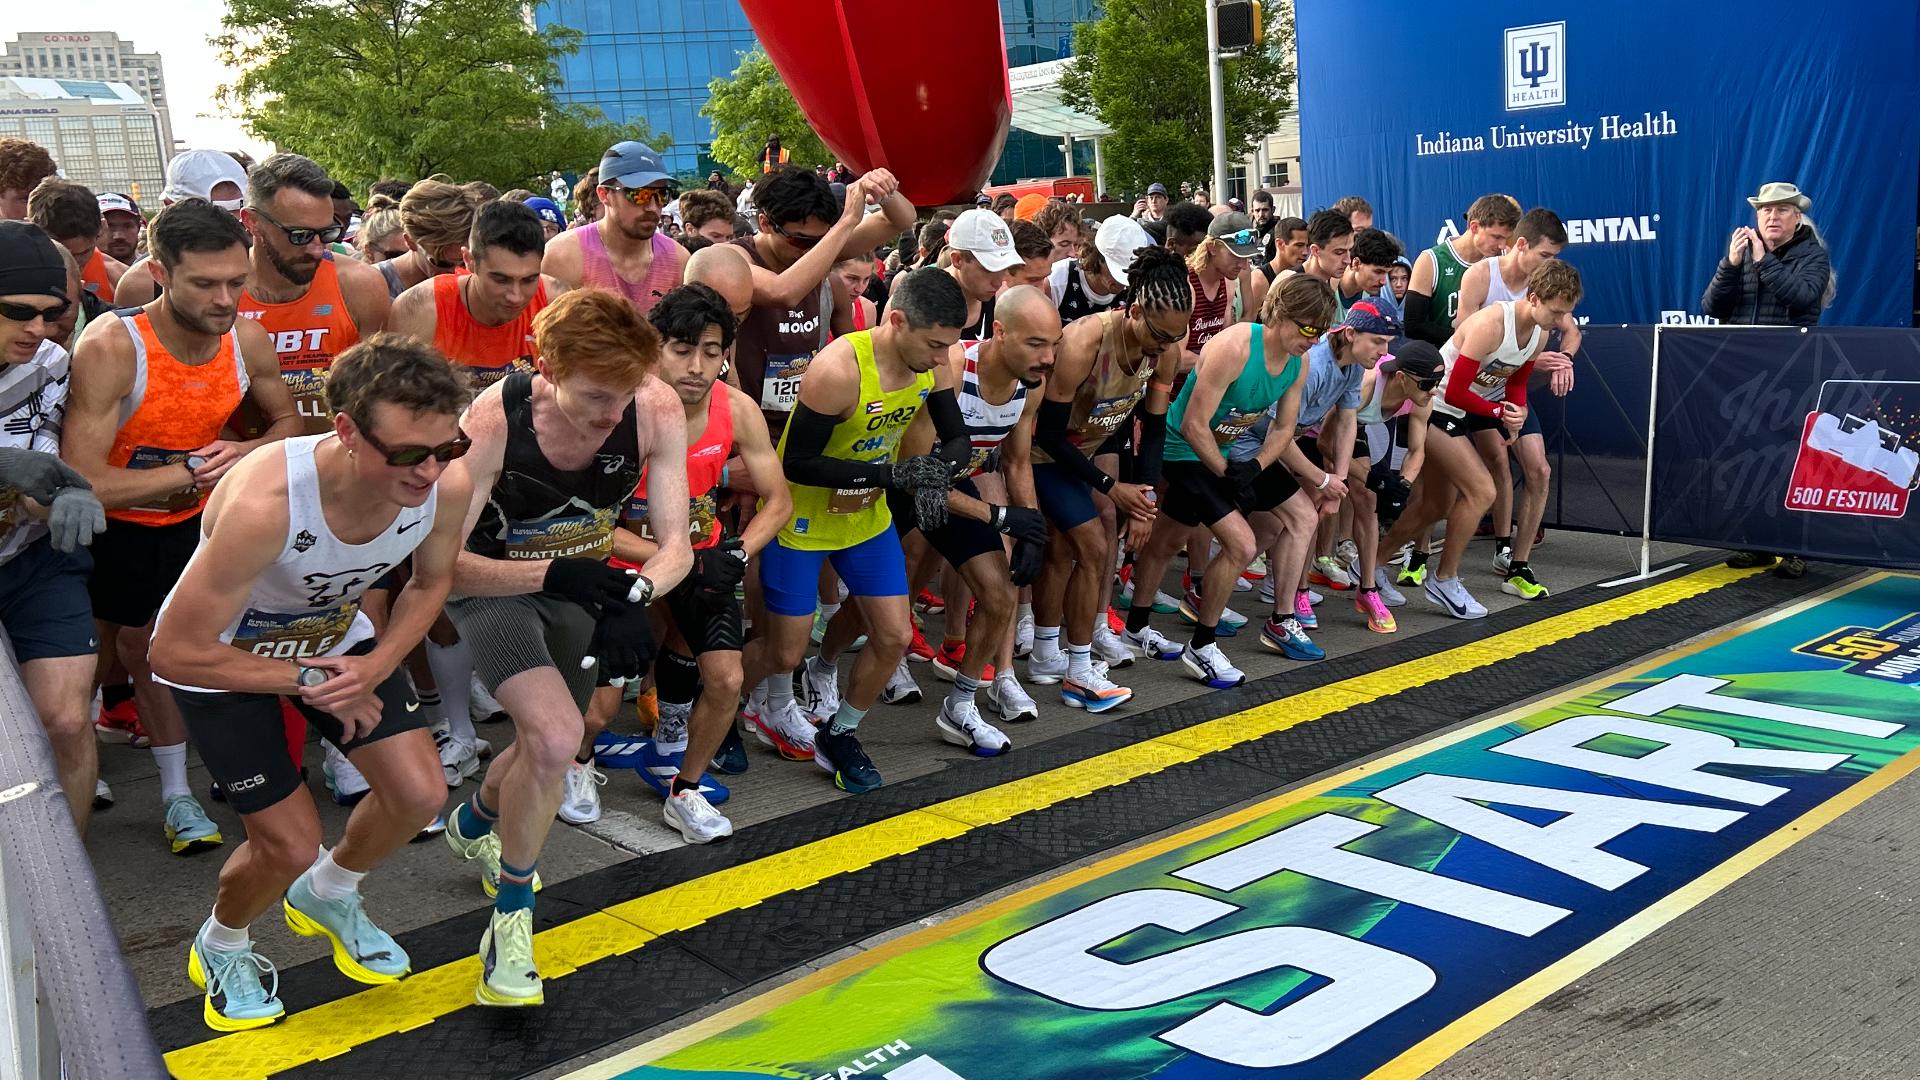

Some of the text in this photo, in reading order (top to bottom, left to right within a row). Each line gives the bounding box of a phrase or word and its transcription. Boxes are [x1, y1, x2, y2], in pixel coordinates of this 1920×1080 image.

[1511, 88, 1558, 102] HEALTH
[1416, 110, 1678, 155] Indiana University Health
[1562, 215, 1657, 243] ENTAL
[268, 328, 330, 353] BT
[1791, 486, 1900, 512] 500 FESTIVAL
[507, 532, 614, 559] QUATTLEBAUM
[251, 634, 336, 658] COLE
[227, 774, 265, 791] UCCS
[981, 672, 1908, 1069] START
